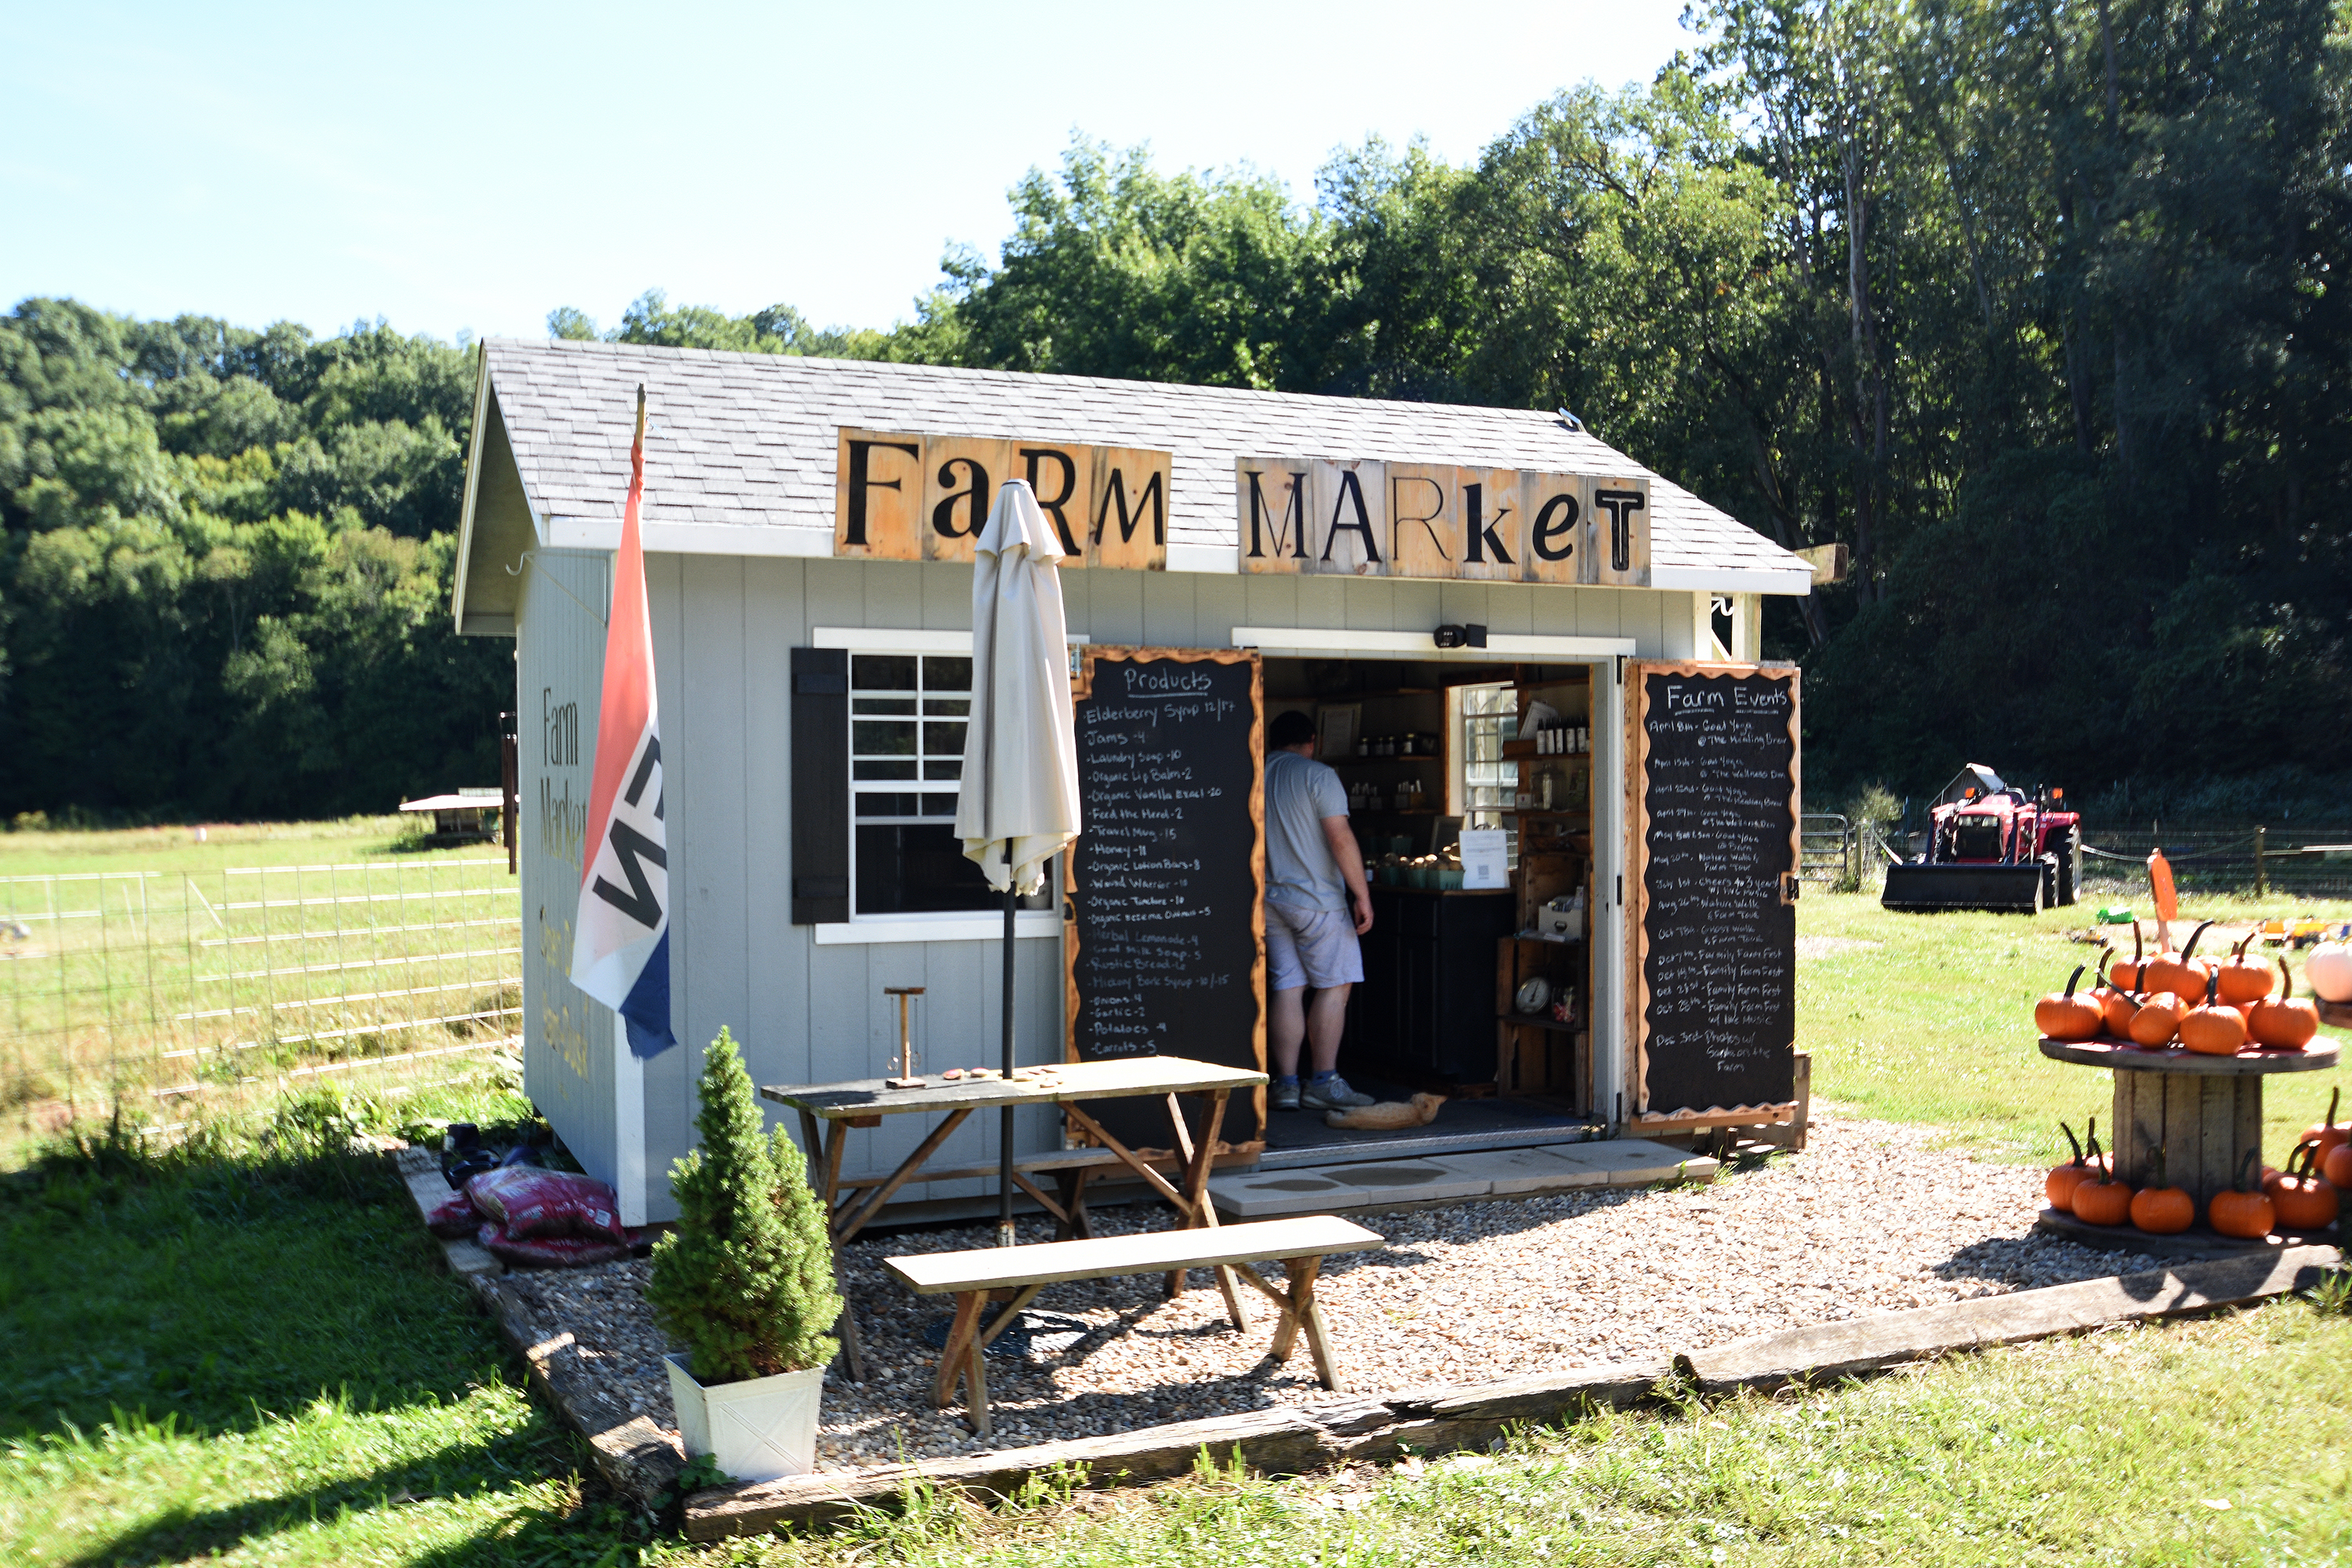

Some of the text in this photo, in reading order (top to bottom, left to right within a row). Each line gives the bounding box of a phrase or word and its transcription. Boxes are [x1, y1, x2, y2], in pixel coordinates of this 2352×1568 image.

[1124, 667, 1212, 691] Products
[1668, 684, 1788, 709] Farm Events
[1086, 706, 1158, 728] Elderberry
[1164, 703, 1200, 723] Syrup
[543, 687, 578, 768] Farm
[1650, 719, 1752, 736] April Goat Yoga
[1087, 730, 1128, 746] Jams
[1138, 752, 1164, 764] Soap
[1720, 756, 1744, 770] Yoga
[1091, 770, 1129, 789] Organic
[1132, 770, 1149, 784] Lip
[1150, 767, 1181, 782] Balm
[1091, 808, 1118, 821] Feed
[1091, 824, 1131, 837] Travel
[1093, 996, 1130, 1006] Onions
[1094, 1007, 1132, 1018] Garlic
[1094, 1022, 1149, 1036] Potatoes
[1094, 1041, 1137, 1054] Carrots
[1717, 1060, 1745, 1072] Farm
